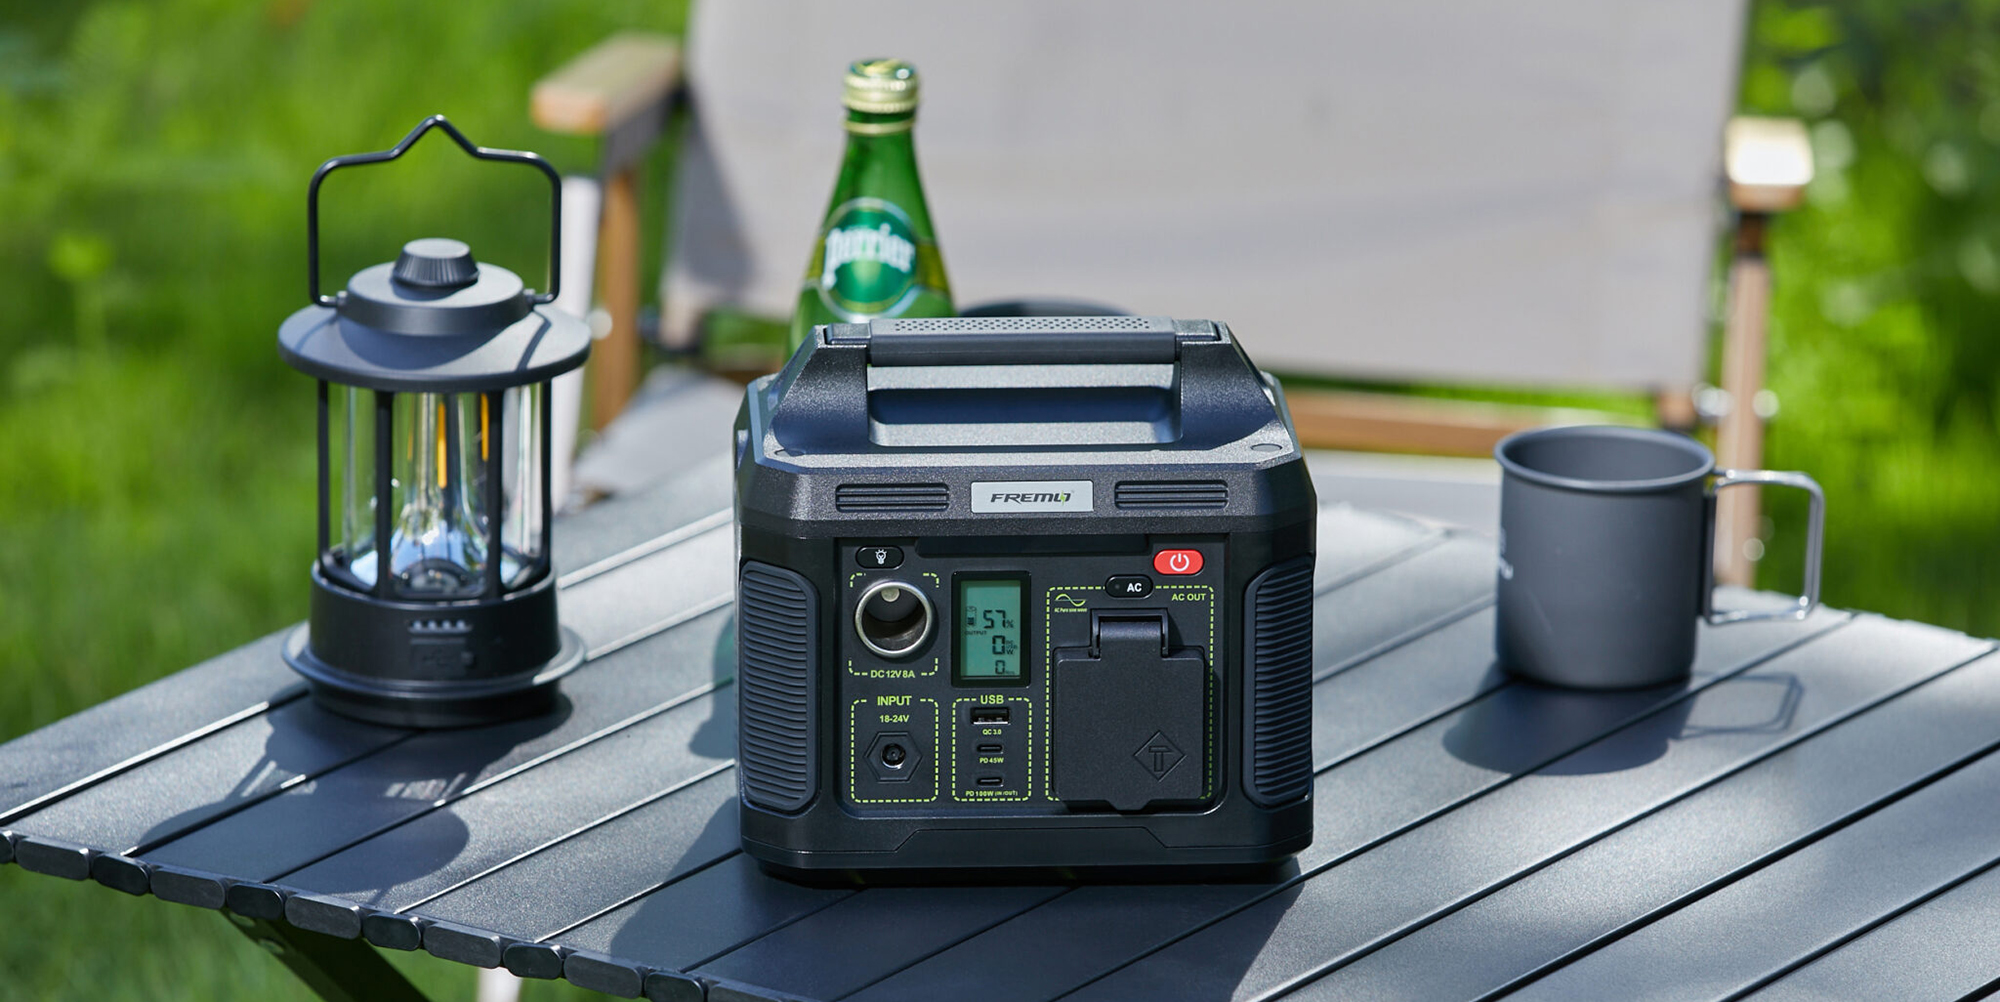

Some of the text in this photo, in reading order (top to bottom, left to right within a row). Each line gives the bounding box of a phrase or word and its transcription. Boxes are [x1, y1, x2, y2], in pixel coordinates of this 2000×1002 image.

[1126, 583, 1143, 593] AC
[1171, 593, 1207, 602] AC OUT
[877, 695, 912, 706] INPUT
[980, 694, 1005, 705] USB
[879, 714, 910, 723] 18-24V
